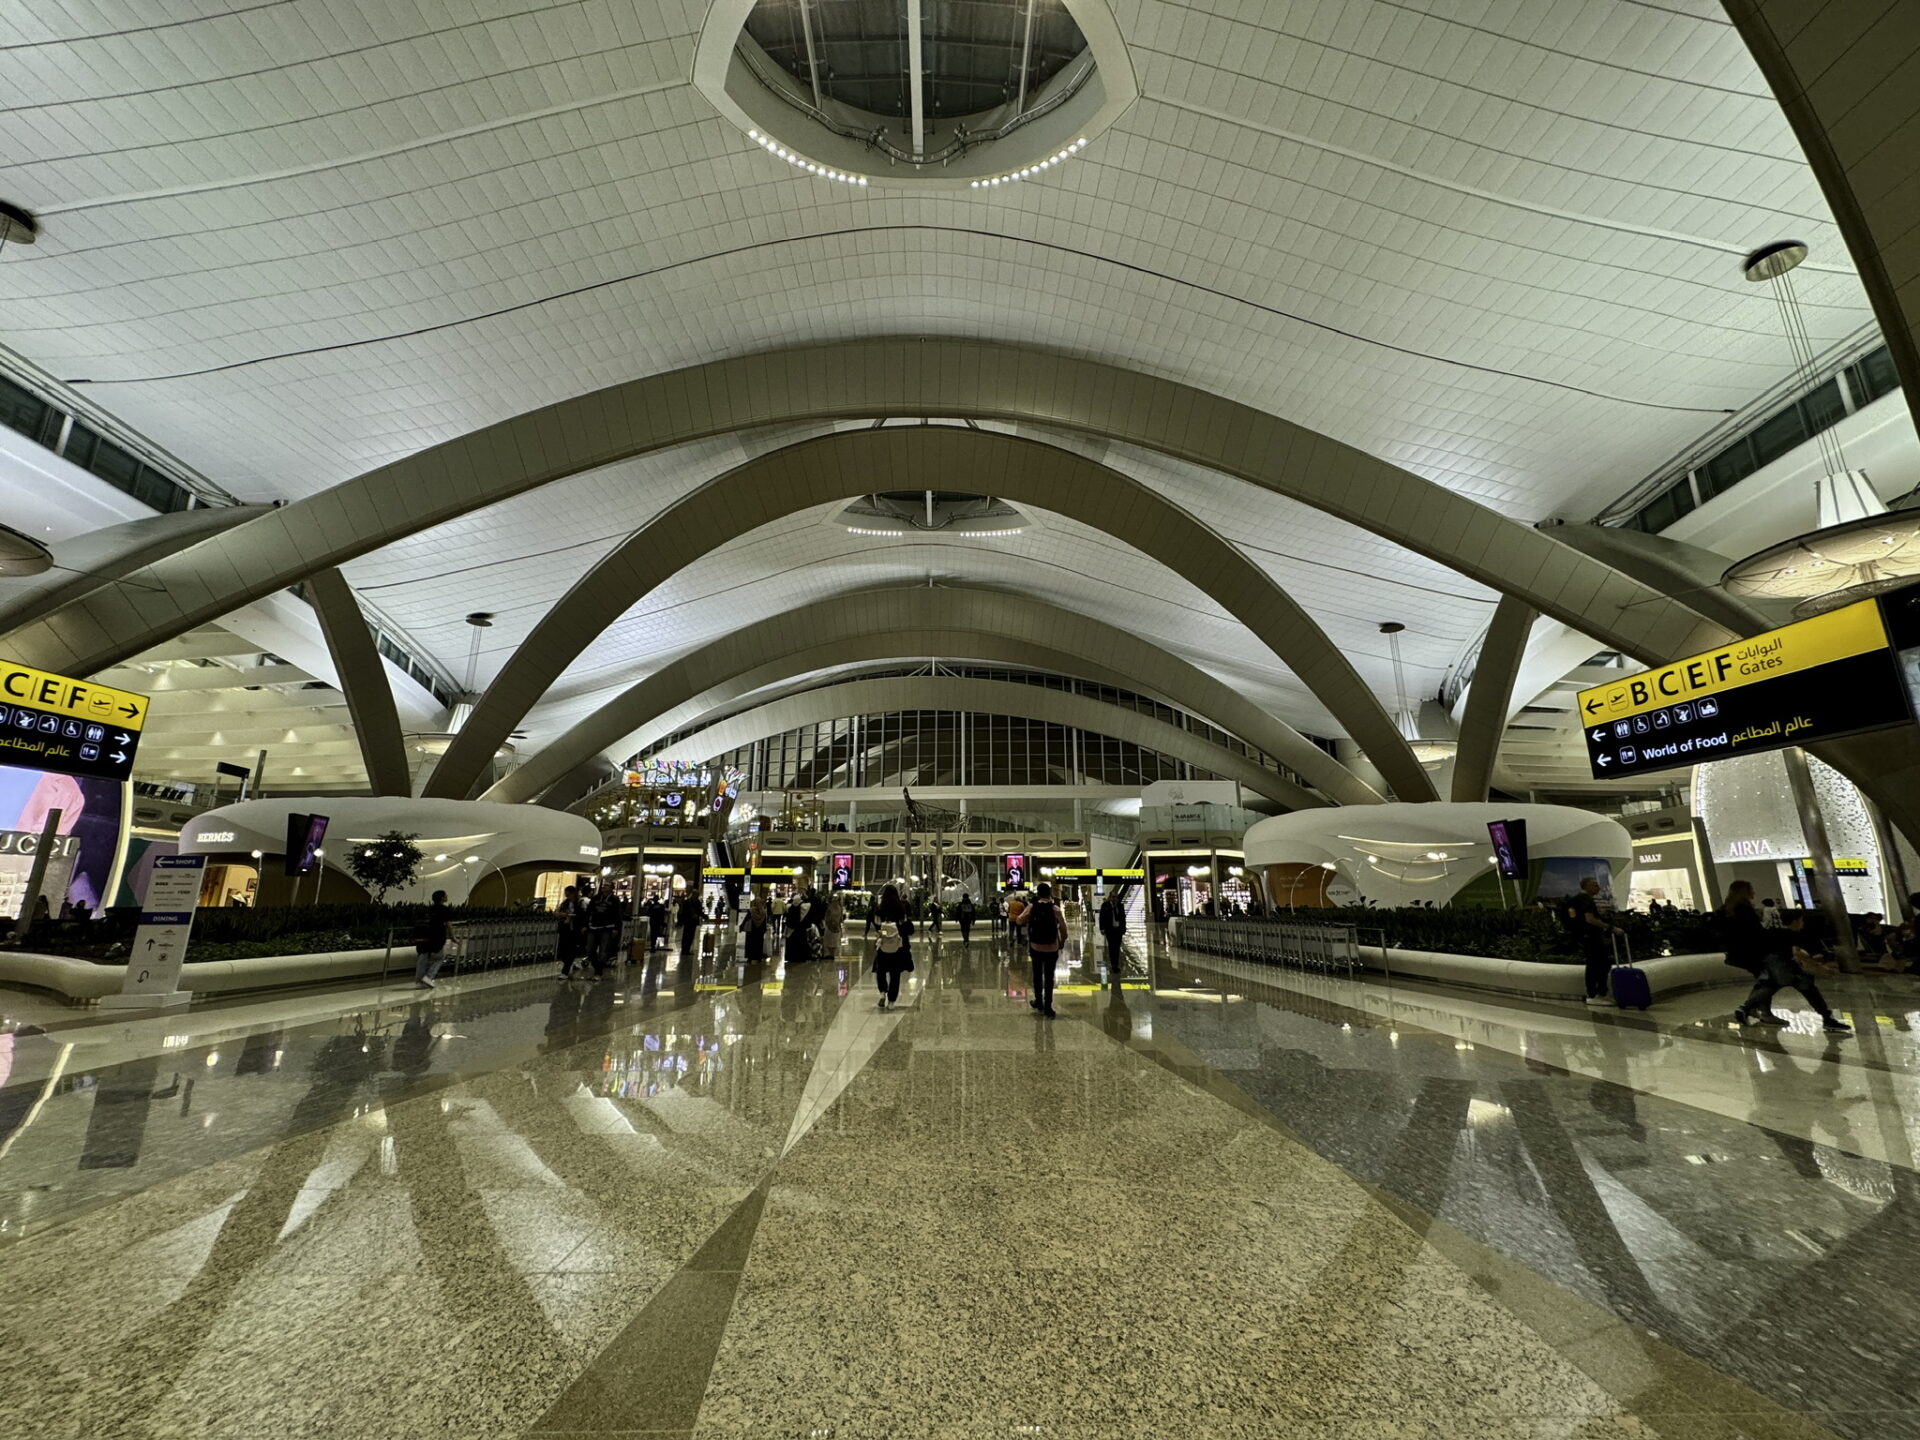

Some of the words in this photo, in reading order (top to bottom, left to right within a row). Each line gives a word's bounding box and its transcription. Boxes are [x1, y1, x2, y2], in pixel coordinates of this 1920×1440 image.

[1736, 637, 1783, 662] البوابات
[1739, 655, 1783, 676] Gates
[4, 672, 30, 698] C
[38, 679, 60, 705] E
[67, 686, 87, 709] F
[1630, 681, 1649, 706] B
[1658, 671, 1679, 696] C
[1687, 662, 1707, 690] E
[1715, 653, 1733, 682] F
[1731, 721, 1781, 747] المطاعم
[1784, 716, 1814, 737] عالم
[44, 745, 70, 757] عالم
[1642, 743, 1678, 760] World
[1679, 740, 1694, 753] of
[1695, 732, 1728, 749] Food
[1729, 839, 1772, 857] AIRYA
